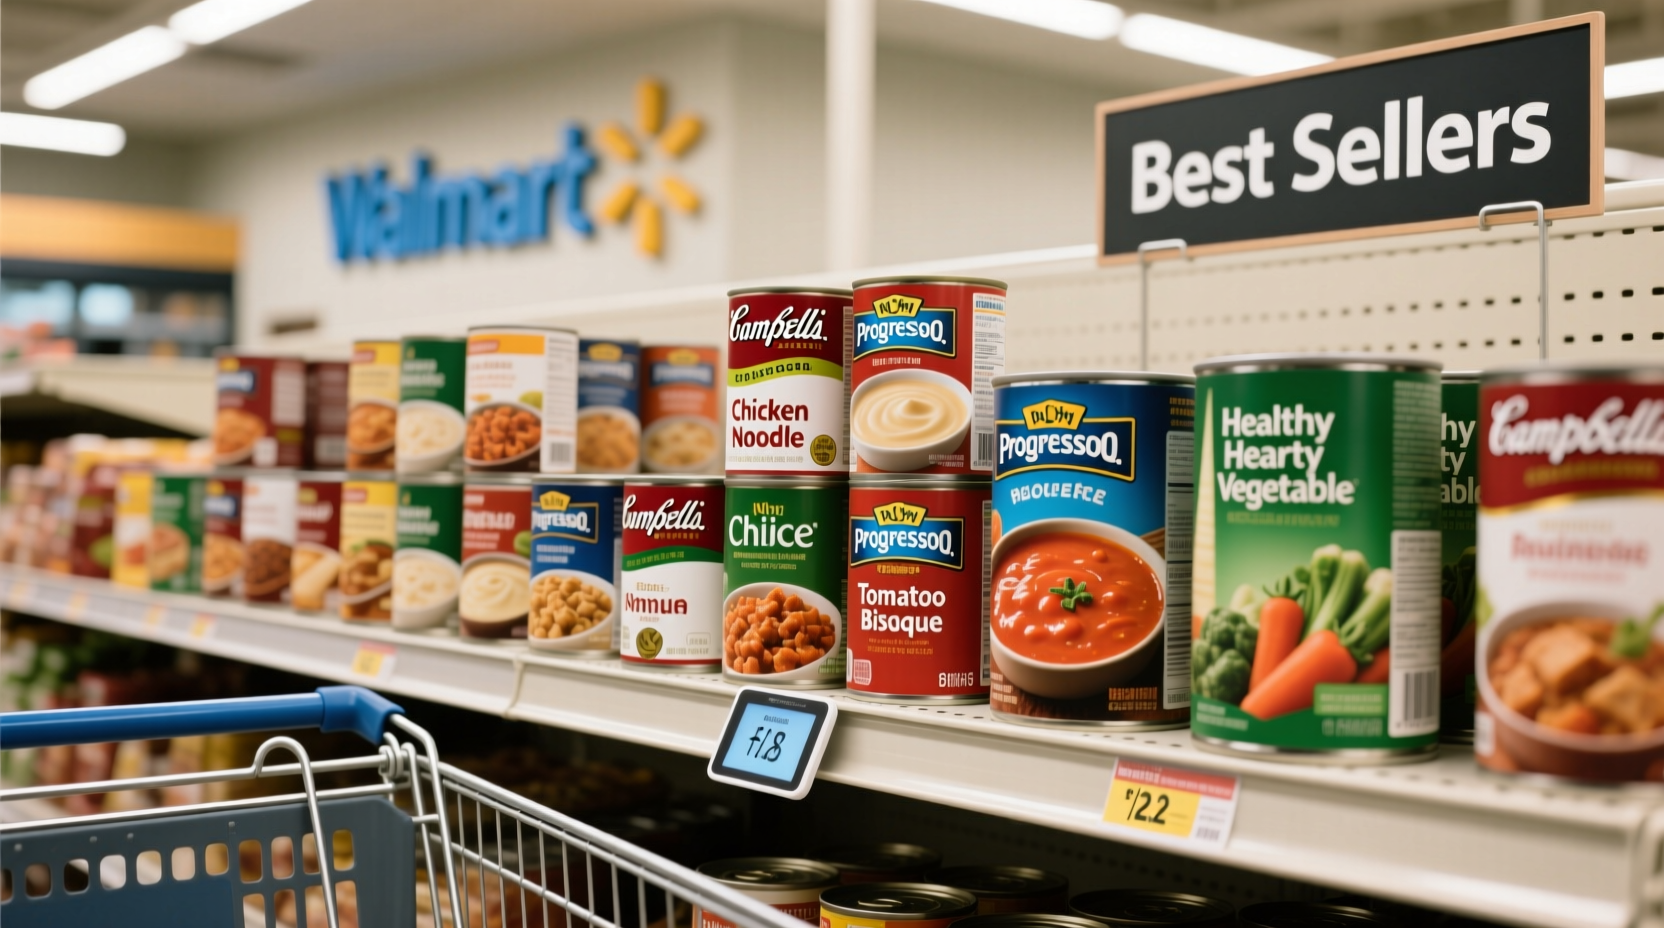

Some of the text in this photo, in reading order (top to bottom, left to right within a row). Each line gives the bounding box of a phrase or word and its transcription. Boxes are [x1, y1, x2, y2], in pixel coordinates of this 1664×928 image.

[1131, 96, 1552, 214] Best Sellers
[326, 122, 597, 264] Walmart
[732, 398, 809, 422] Chicken
[1221, 403, 1336, 445] Healthy
[732, 424, 805, 449] Noodle
[1223, 440, 1325, 478] Hearty
[1216, 471, 1356, 511] Vegetable
[857, 582, 946, 607] Tomatoo
[860, 608, 943, 639] Bisoque
